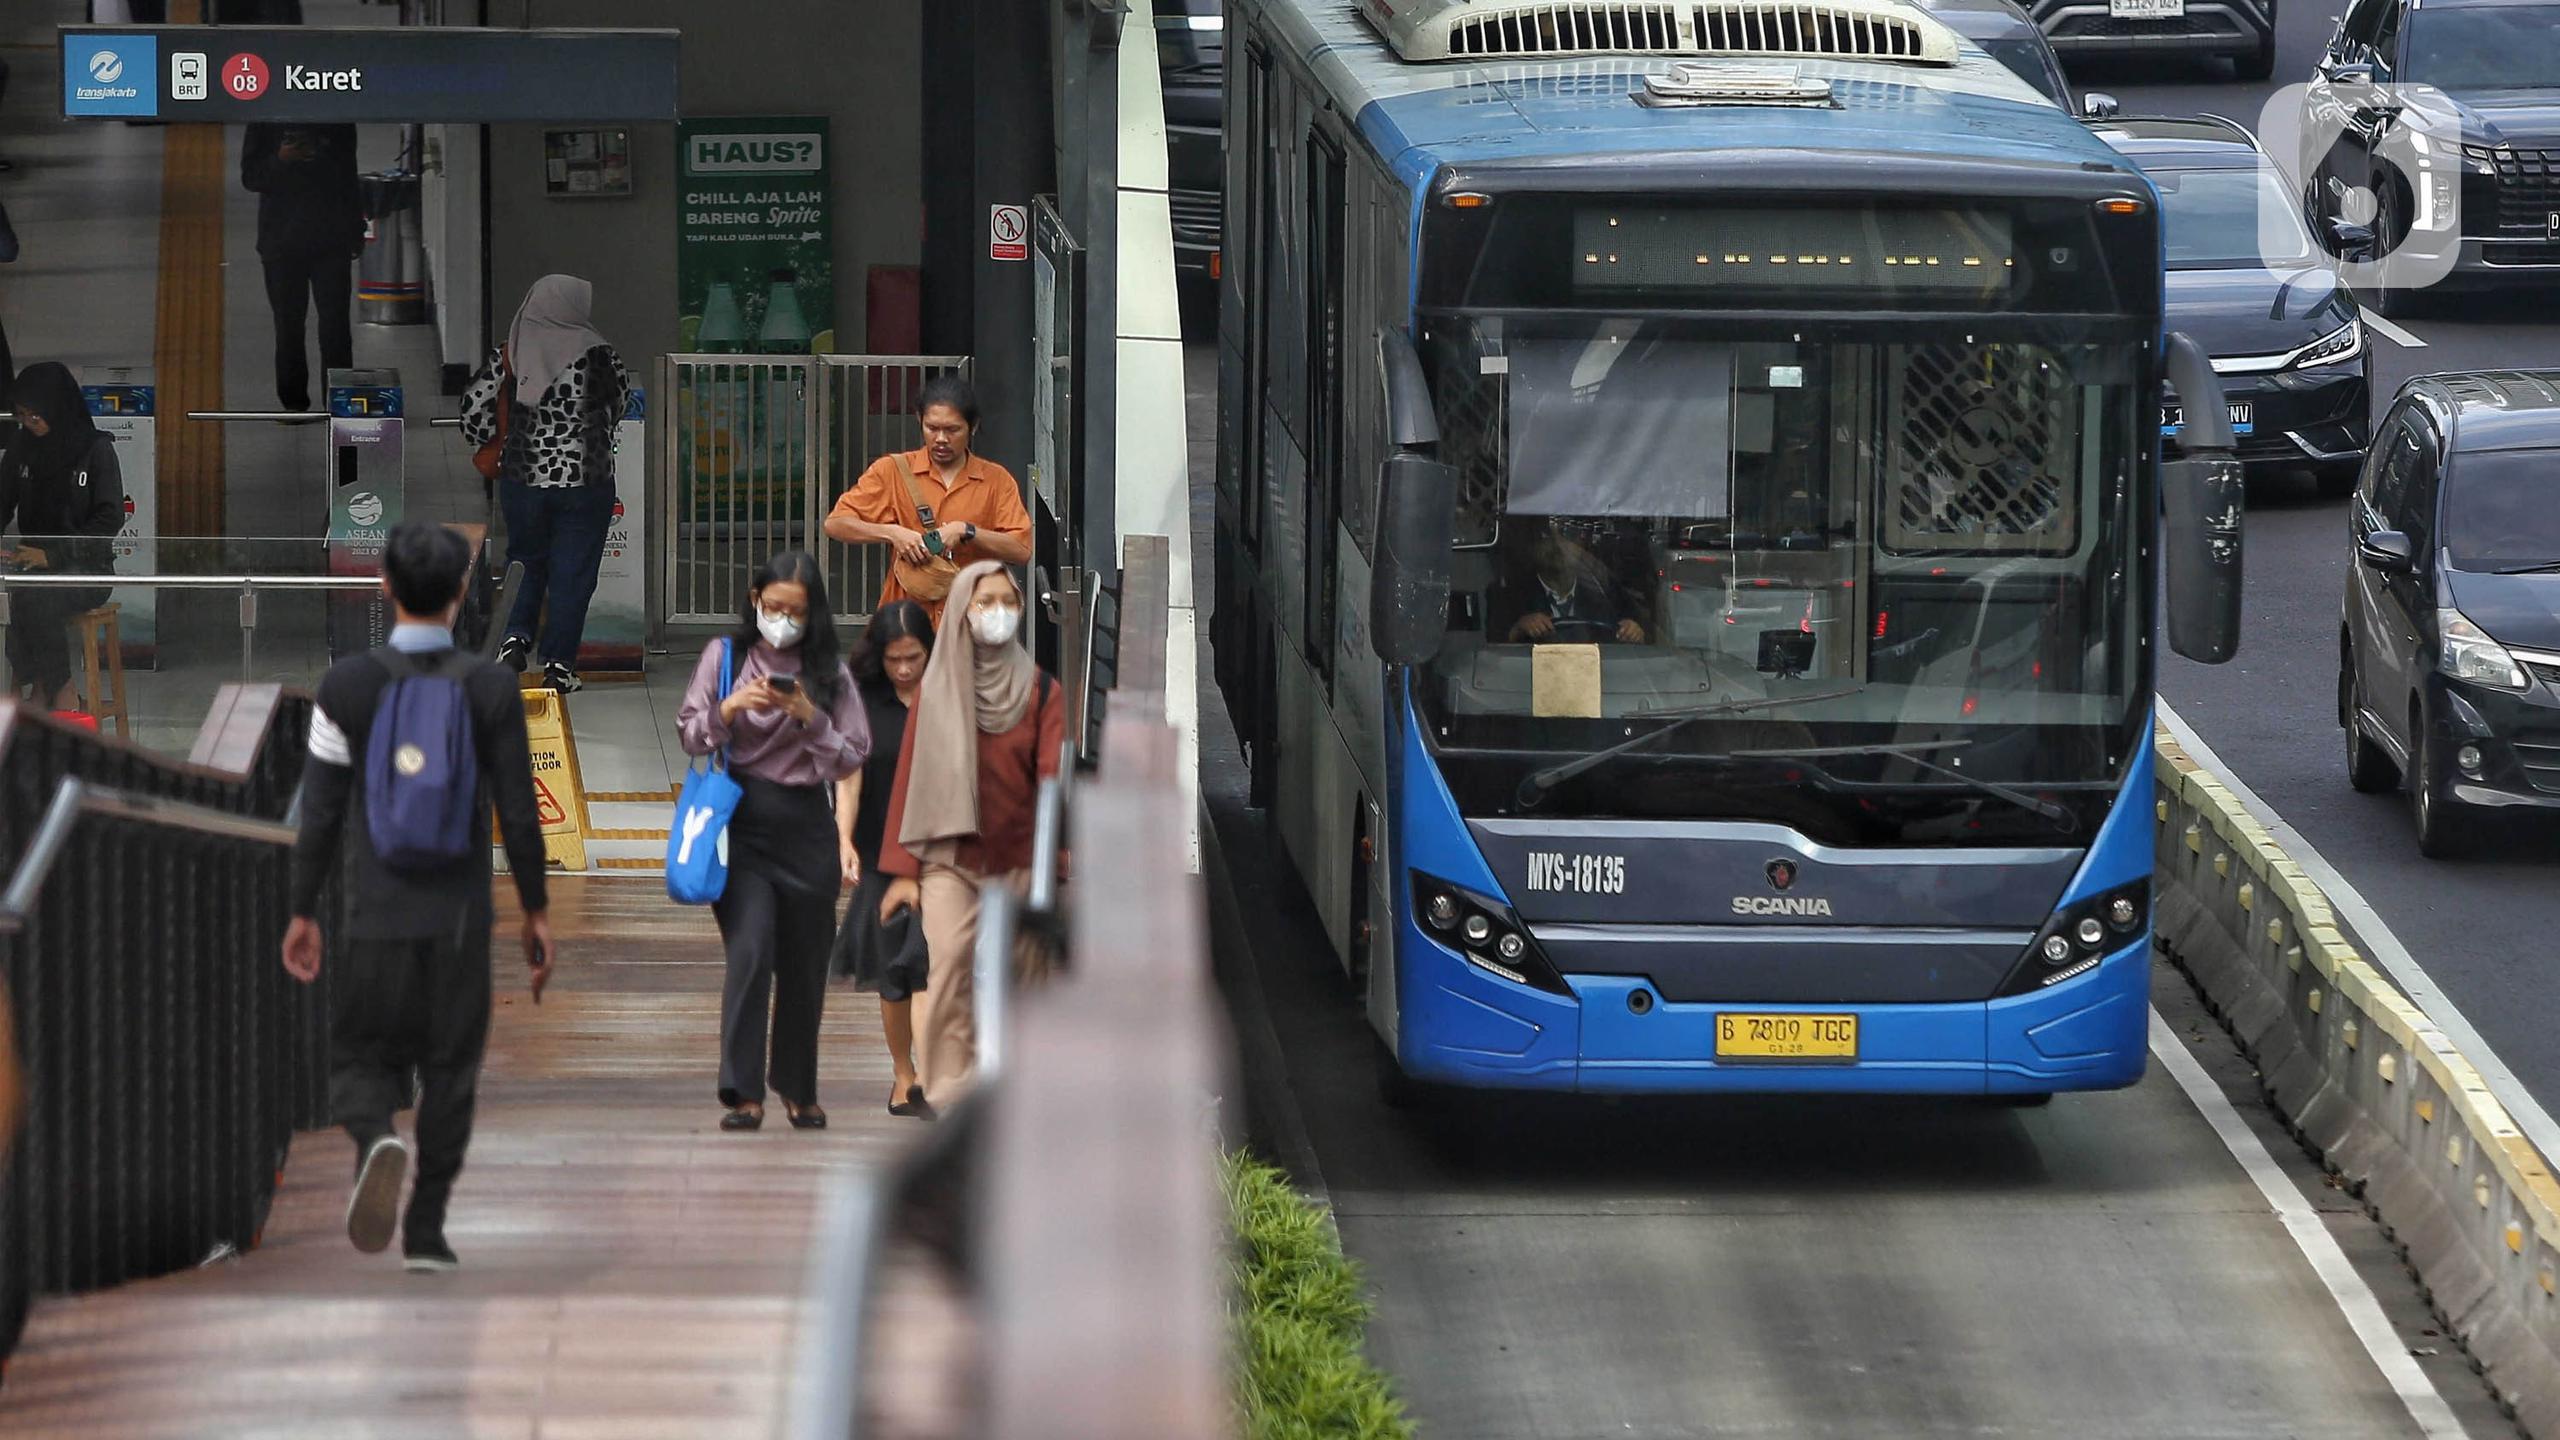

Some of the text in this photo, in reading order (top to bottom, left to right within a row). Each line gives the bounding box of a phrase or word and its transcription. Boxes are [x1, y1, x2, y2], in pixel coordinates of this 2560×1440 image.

[241, 57, 250, 71] 1
[233, 75, 257, 92] 08
[285, 65, 362, 90] Karet
[178, 85, 200, 95] BRT
[698, 141, 813, 163] HAUS?
[686, 191, 821, 204] CHILL AJA LAH
[686, 206, 821, 227] BARENG Sprite
[2230, 405, 2249, 423] NV
[345, 529, 386, 540] ASEAN
[531, 760, 561, 771] FLOOR
[1527, 852, 1625, 894] MYS-18135
[1731, 896, 1832, 916] SCANIA
[1723, 1019, 1852, 1041] B 7809 TGC
